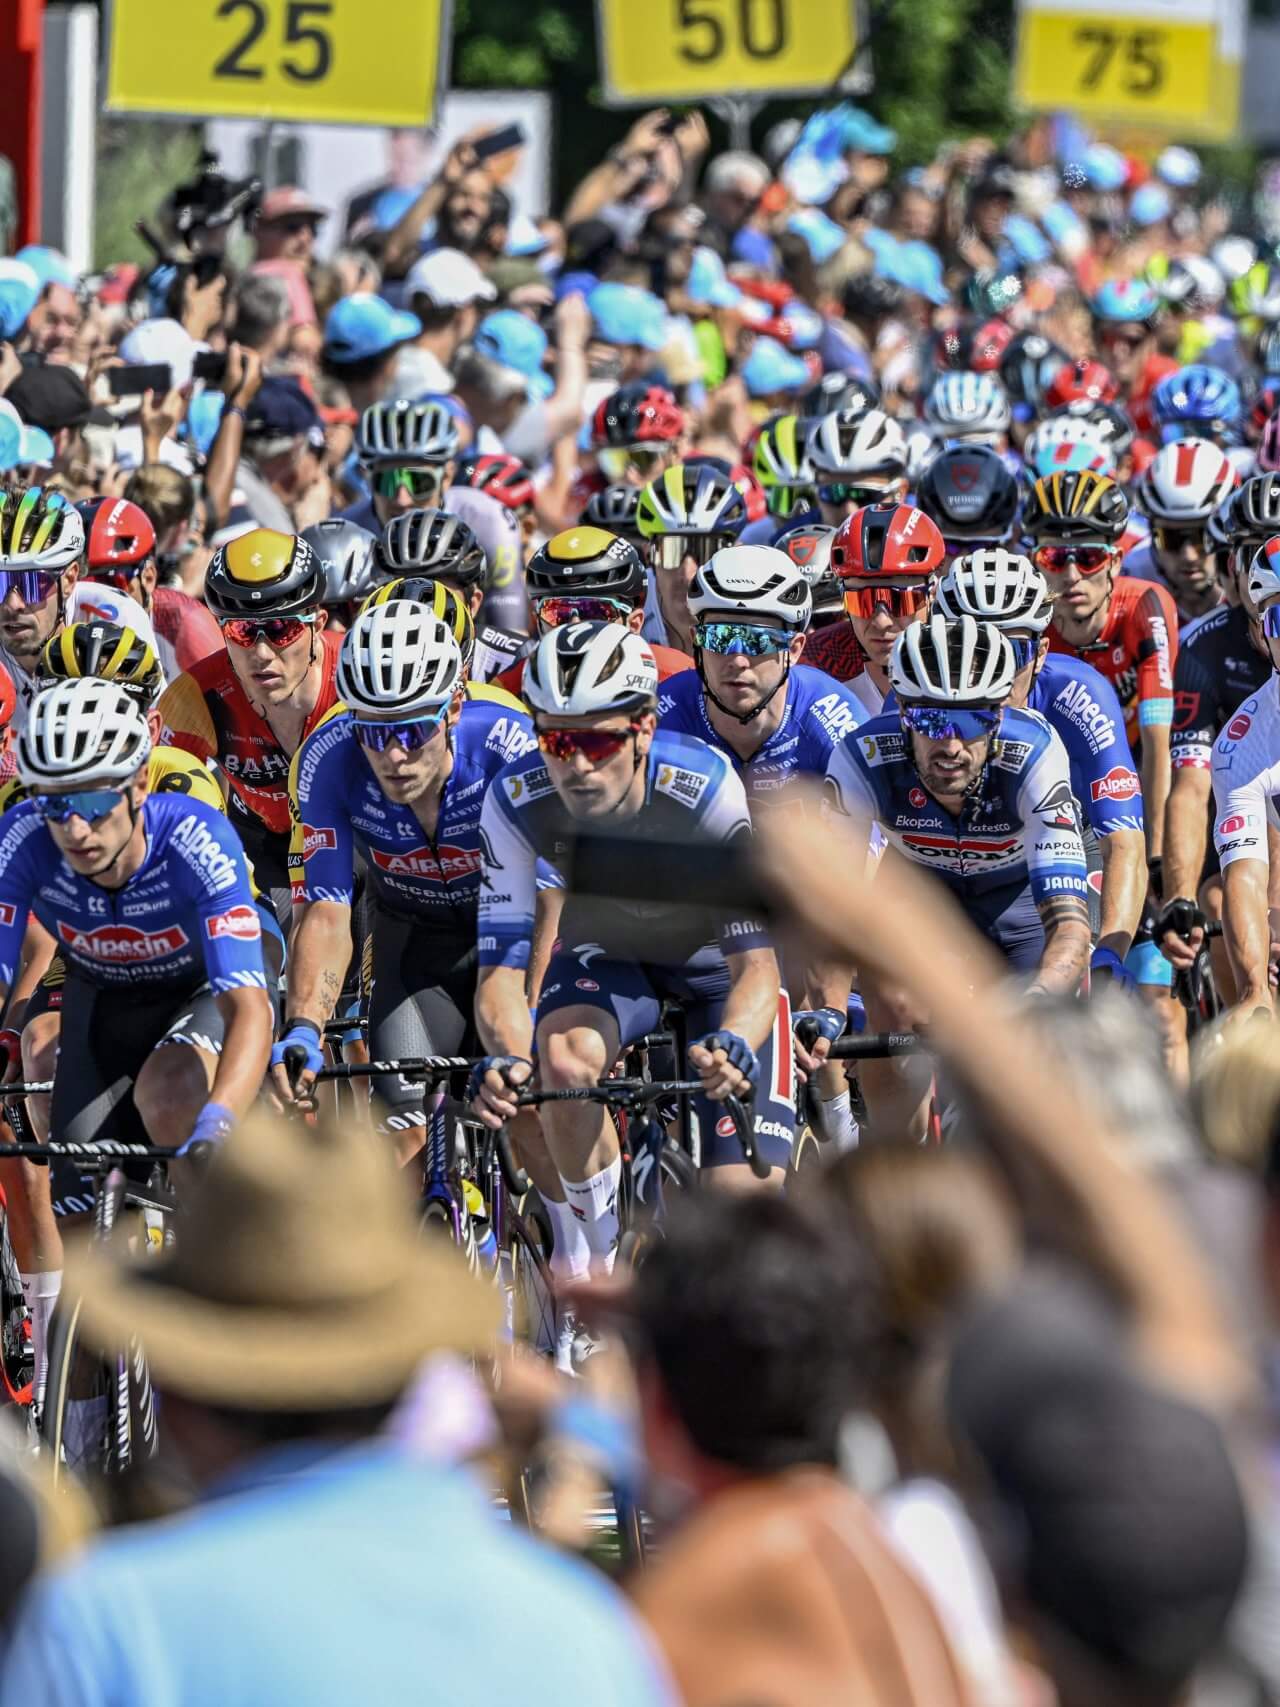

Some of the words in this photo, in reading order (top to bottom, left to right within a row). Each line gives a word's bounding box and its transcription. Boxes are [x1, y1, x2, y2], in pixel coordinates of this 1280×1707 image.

[214, 0, 332, 82] 25
[677, 0, 786, 63] 50
[1075, 27, 1166, 94] 75
[482, 627, 523, 651] BMC
[1148, 616, 1173, 690] MERIDA
[1056, 680, 1116, 752] Alpecin
[297, 720, 351, 803] deceuninck
[173, 815, 238, 891] Alpecin
[896, 815, 943, 829] Ekopak
[72, 936, 170, 957] Alpecin
[436, 1113, 447, 1172] CANYON
